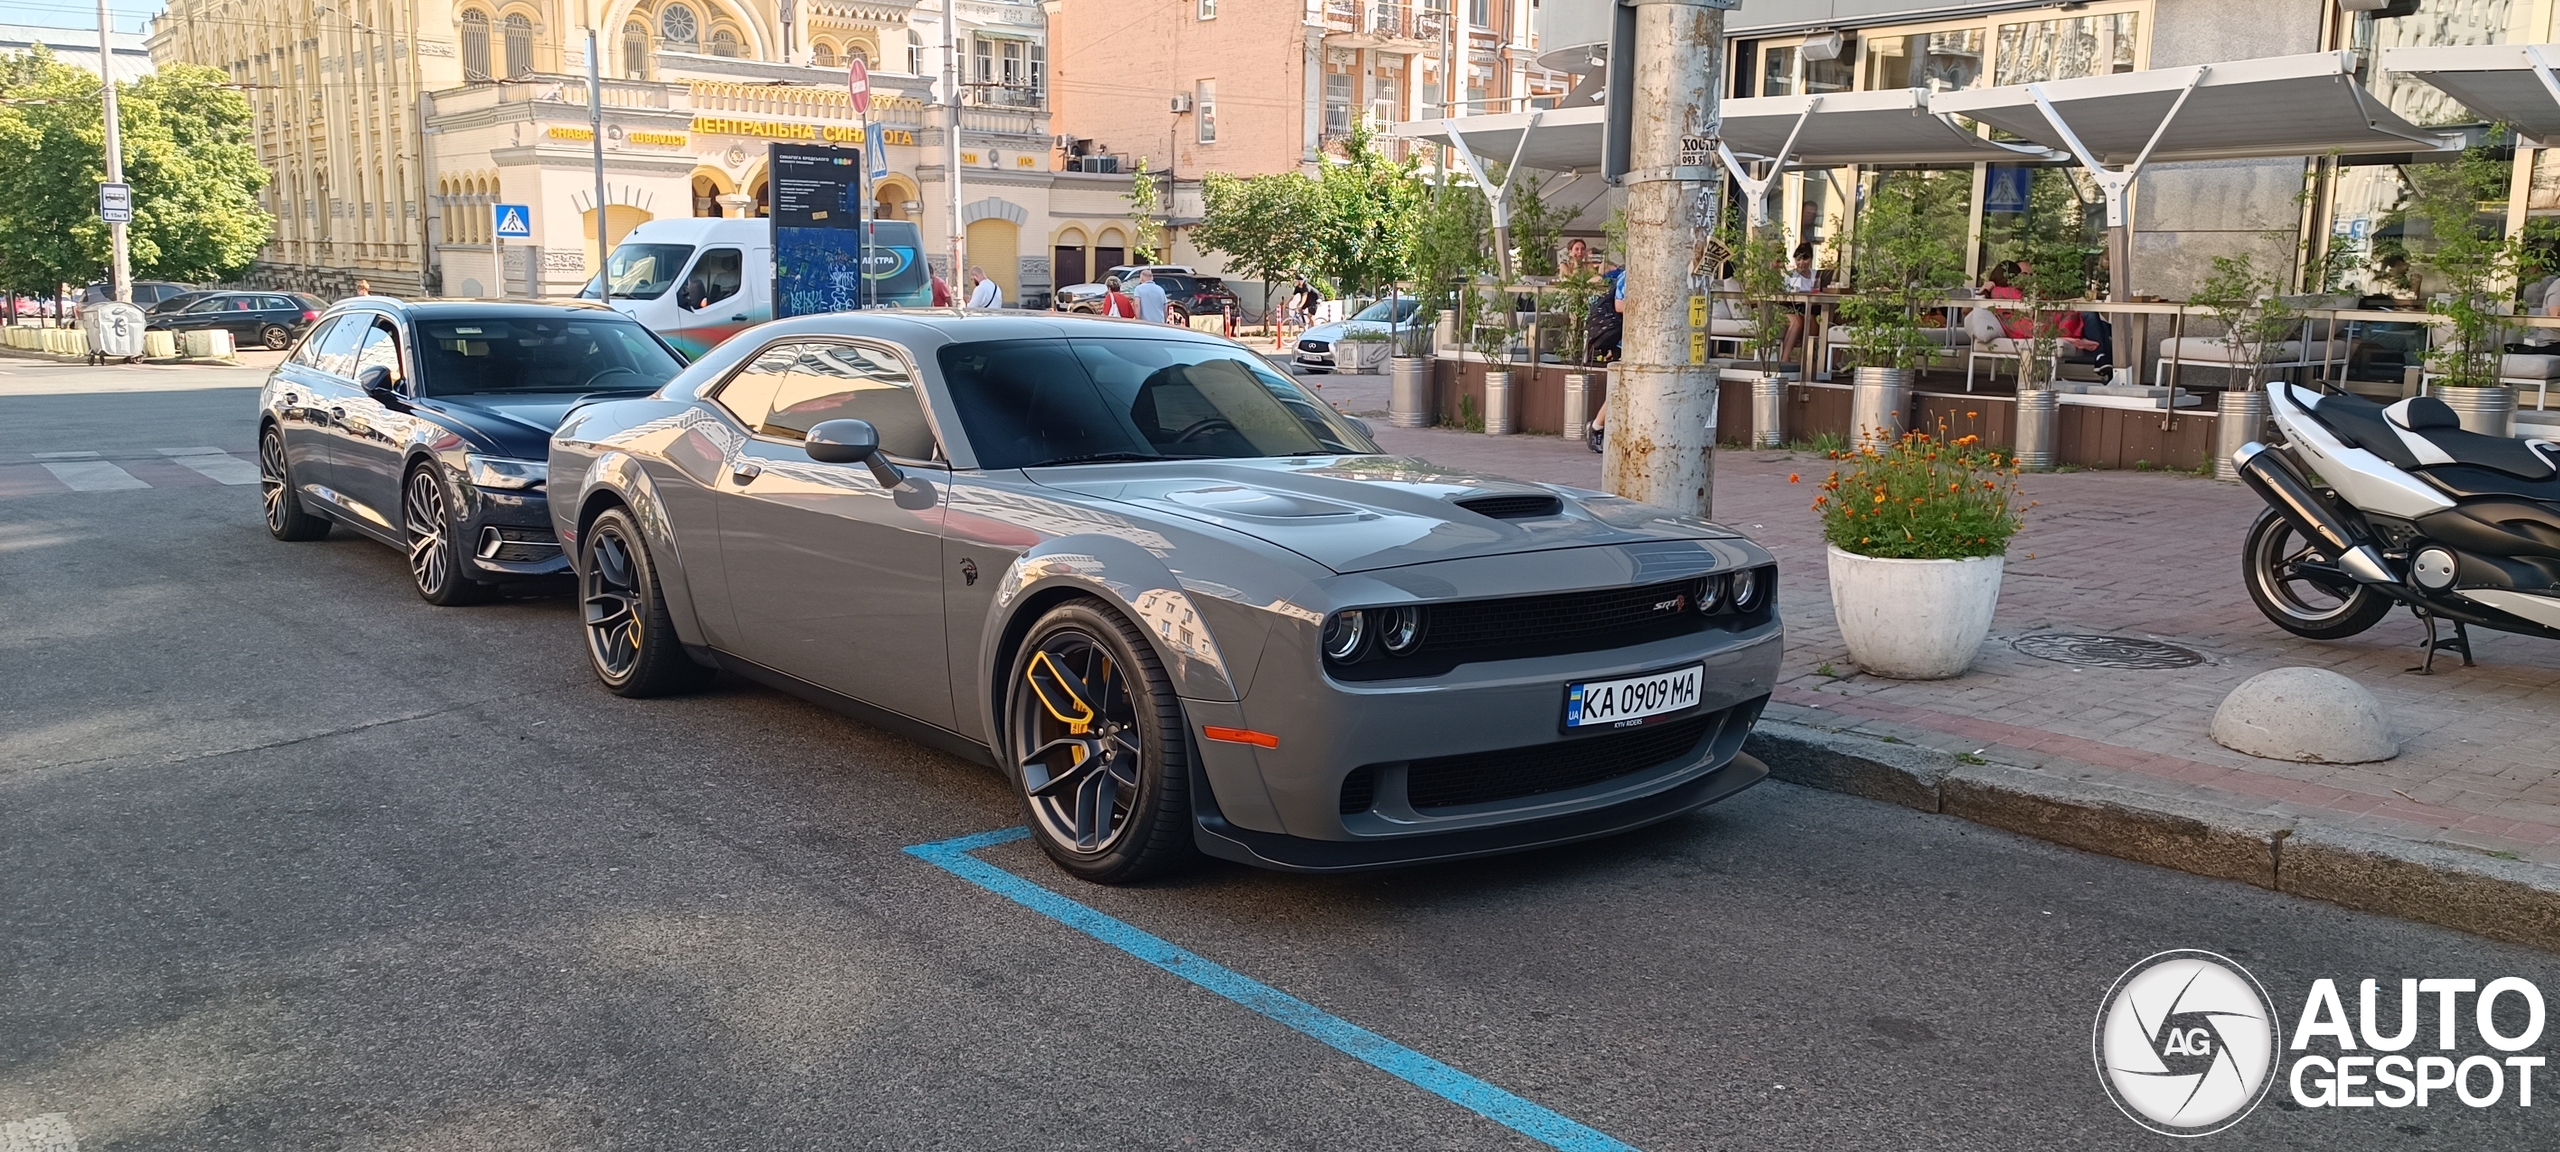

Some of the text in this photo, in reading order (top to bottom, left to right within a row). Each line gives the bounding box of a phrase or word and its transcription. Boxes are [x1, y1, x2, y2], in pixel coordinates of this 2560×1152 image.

[548, 127, 595, 142] CHABA
[690, 117, 914, 146] ЦЕНТРАЛЬНА СИНАОГА
[1652, 599, 1679, 611] SRT
[1582, 672, 1694, 720] KA 0909 MA
[1569, 710, 1579, 720] UA
